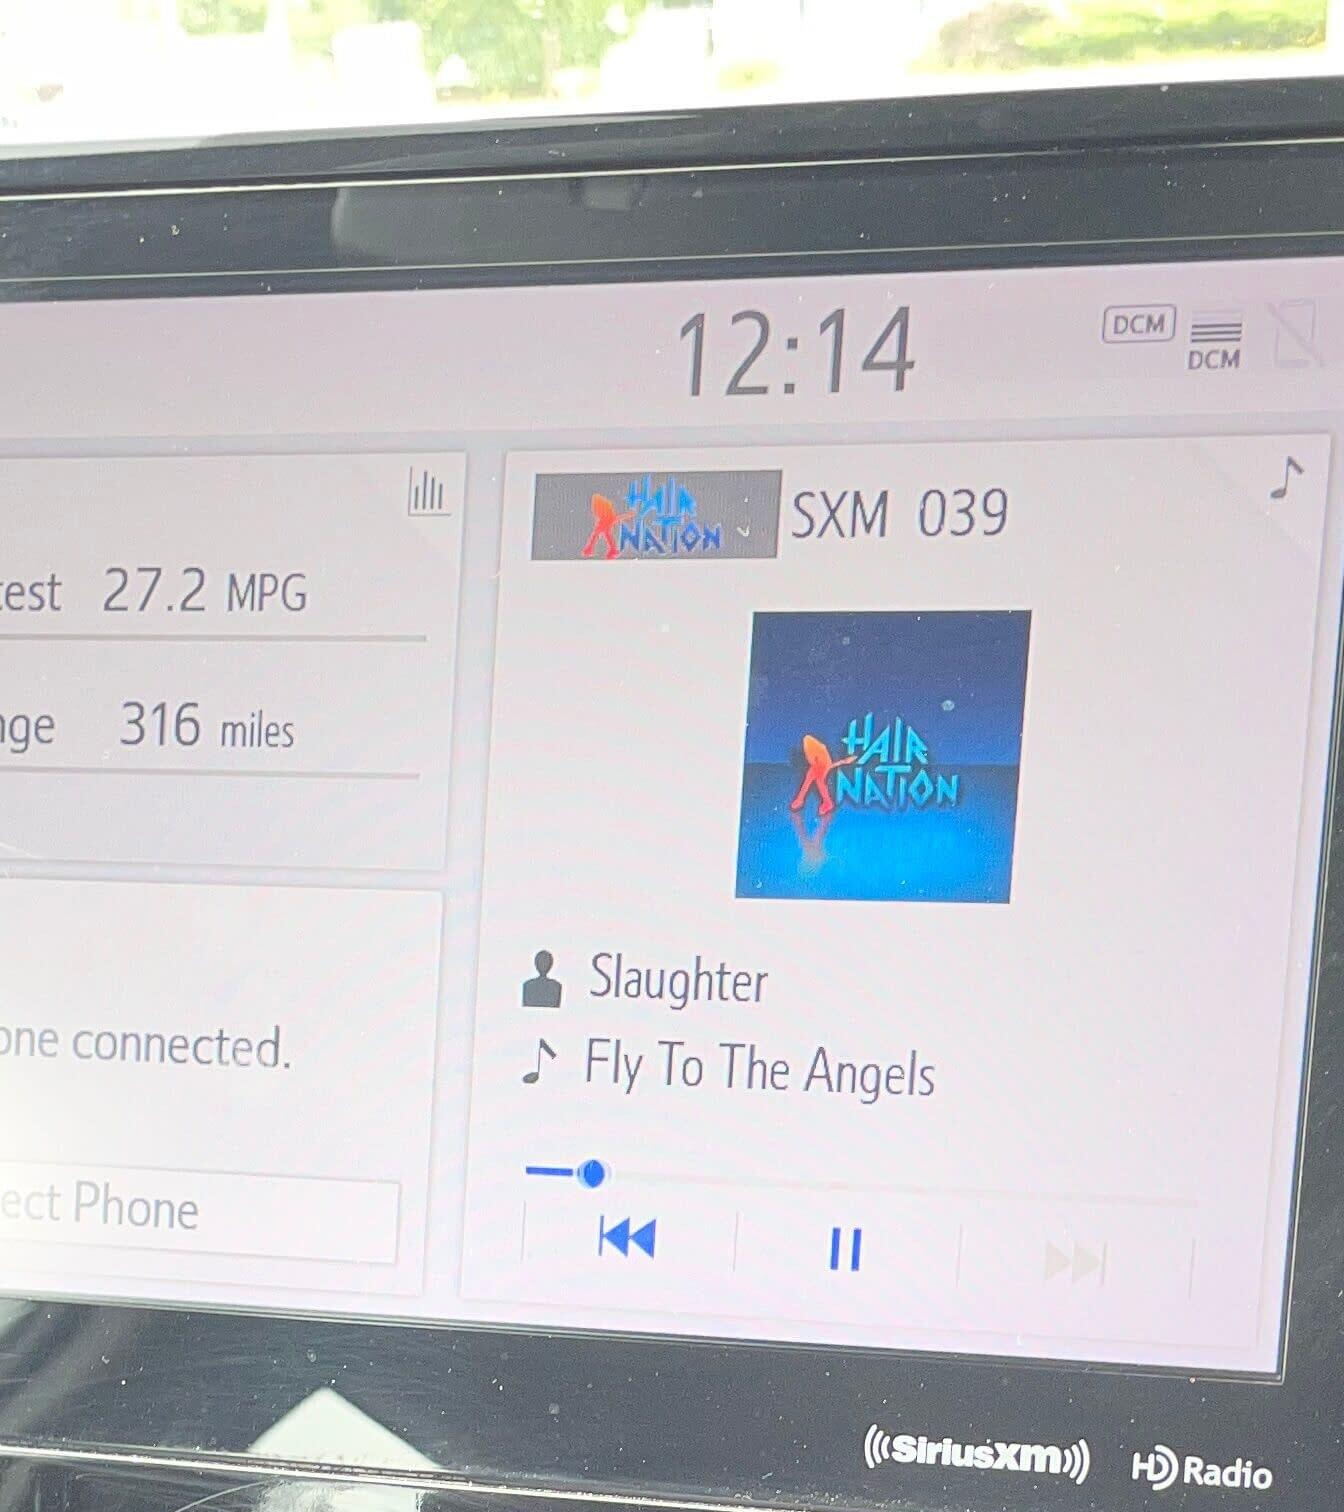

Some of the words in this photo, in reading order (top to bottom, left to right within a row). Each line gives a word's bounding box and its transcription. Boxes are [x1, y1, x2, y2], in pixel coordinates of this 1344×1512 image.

[1113, 314, 1166, 334] DCM
[680, 305, 915, 397] 12:14
[1187, 348, 1241, 370] DCM
[617, 515, 722, 555] NATION
[792, 490, 889, 539] SXM
[919, 487, 1009, 538] 039
[103, 567, 206, 612] 27.2
[226, 572, 308, 612] MPG
[120, 701, 201, 746] 316
[220, 710, 296, 748] miles
[842, 711, 929, 765] HAIR
[836, 765, 959, 807] NATION
[590, 952, 769, 1010] Slaughter
[72, 1025, 292, 1069] connected.
[585, 1037, 644, 1095] Fly
[658, 1040, 704, 1088] To
[719, 1042, 790, 1091] The
[803, 1046, 936, 1104] Angels
[73, 1179, 200, 1231] Phone
[1183, 1456, 1273, 1490] Radio
